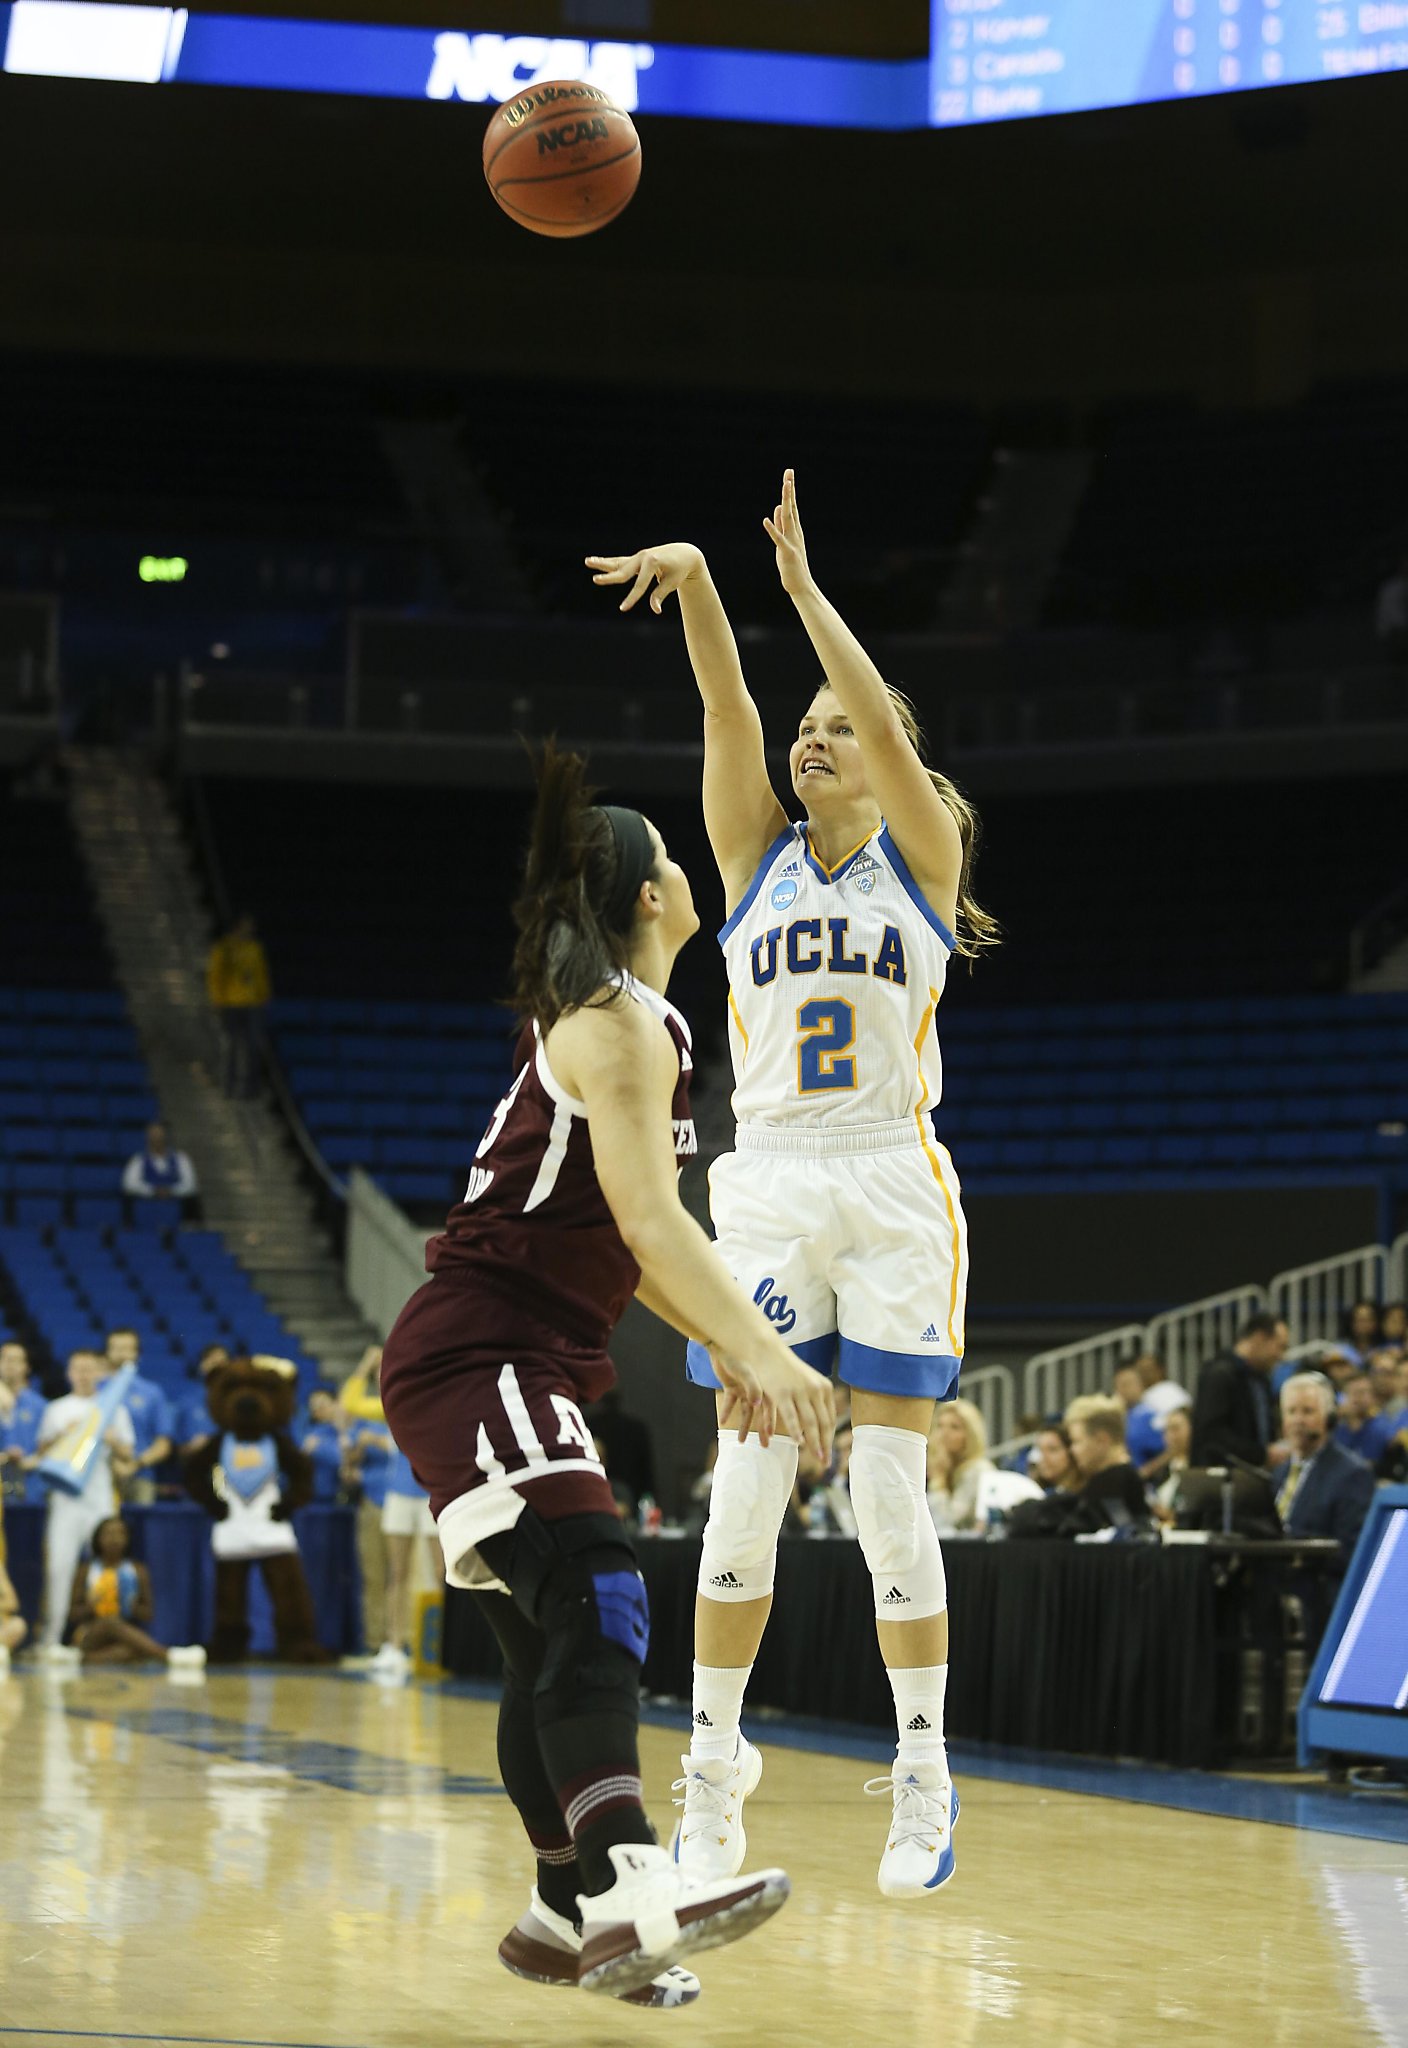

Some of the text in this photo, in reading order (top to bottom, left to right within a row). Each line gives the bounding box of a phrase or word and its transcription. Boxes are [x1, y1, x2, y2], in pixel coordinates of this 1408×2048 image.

[426, 31, 642, 112] NCAA
[536, 117, 609, 155] NCAA
[750, 917, 908, 989] UCLA
[796, 995, 858, 1095] 2
[752, 1276, 798, 1335] la
[709, 1577, 744, 1589] adidas
[882, 1596, 912, 1605] adidas
[906, 1722, 932, 1731] adidas
